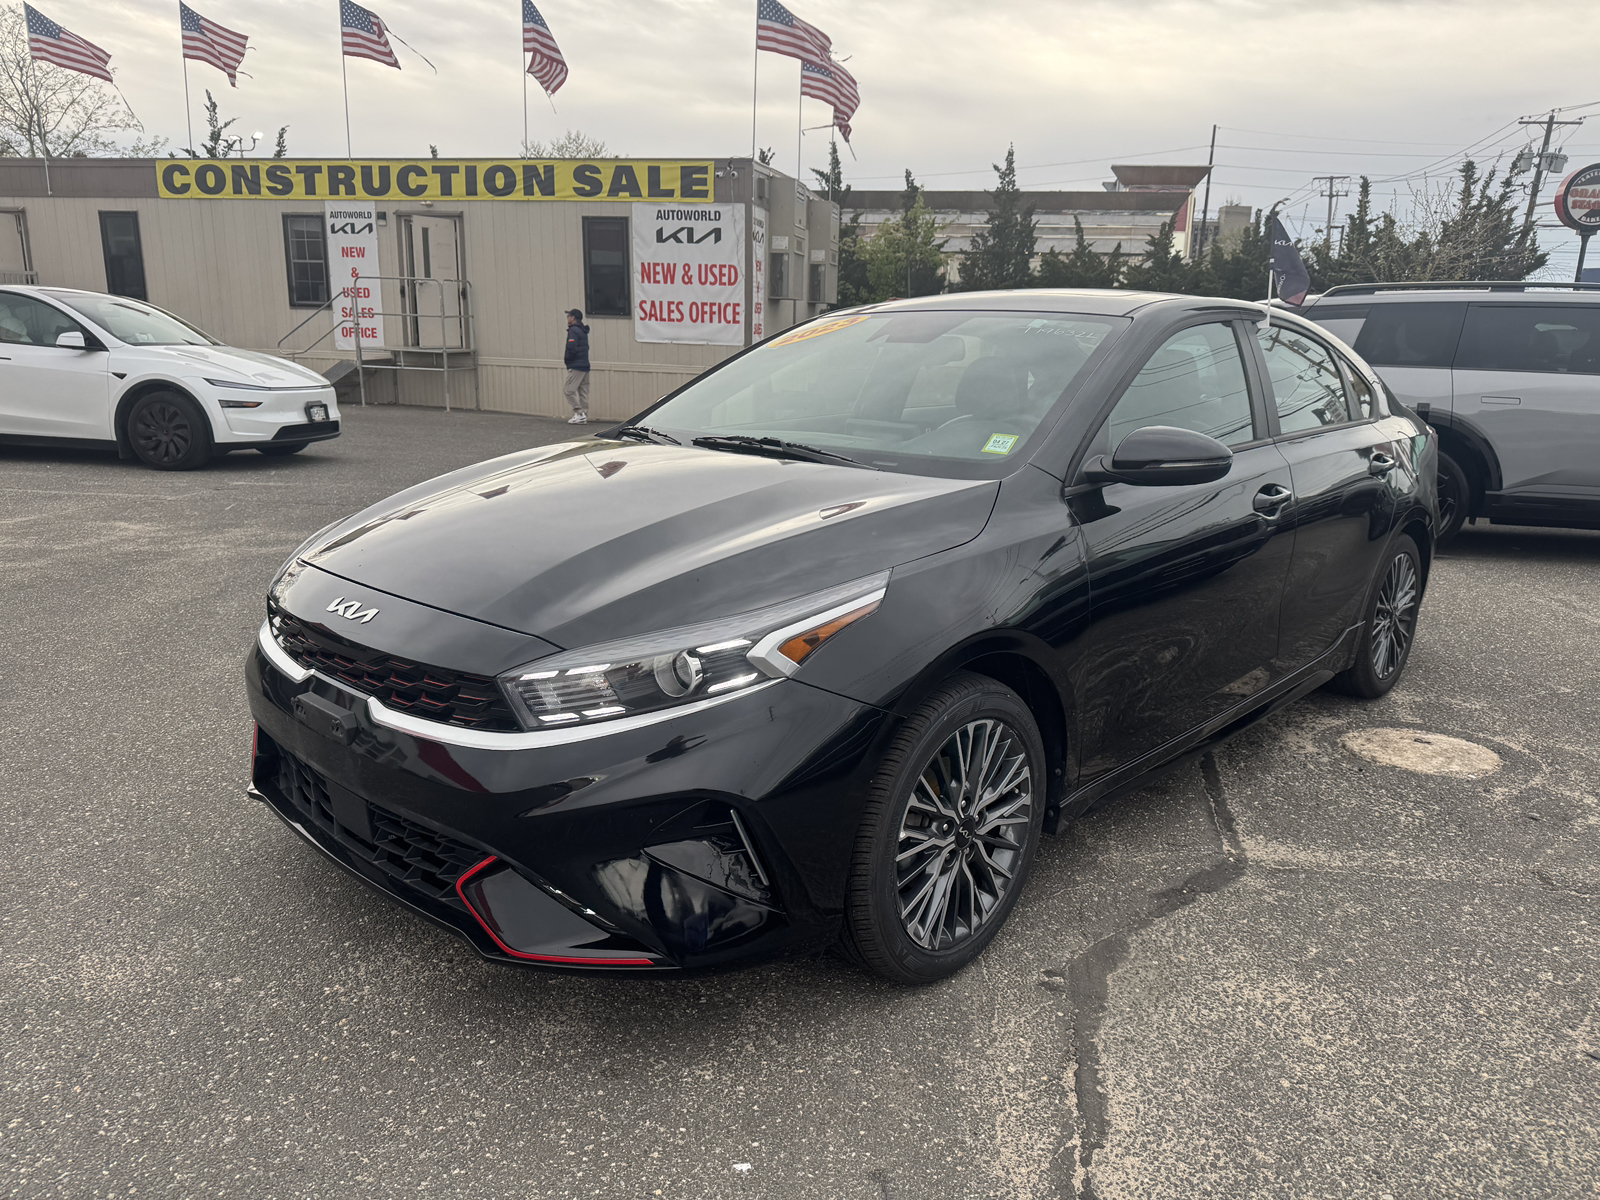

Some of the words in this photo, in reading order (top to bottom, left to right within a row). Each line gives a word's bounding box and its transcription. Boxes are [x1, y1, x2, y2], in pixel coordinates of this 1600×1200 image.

[162, 164, 555, 196] CONSTRUCTION
[572, 164, 709, 198] SALE
[330, 211, 372, 219] AUTOWORLD
[656, 209, 721, 221] AUTOWORLD
[330, 222, 373, 234] KIA
[656, 226, 721, 244] KIA
[1274, 239, 1292, 247] KIA
[342, 247, 365, 258] NEW
[351, 267, 359, 278] &
[641, 262, 676, 284] NEW
[681, 263, 693, 285] &
[698, 264, 738, 286] USED
[342, 287, 370, 298] USED
[639, 300, 684, 322] SALES
[689, 301, 740, 324] OFFICE
[326, 596, 380, 625] KIA
